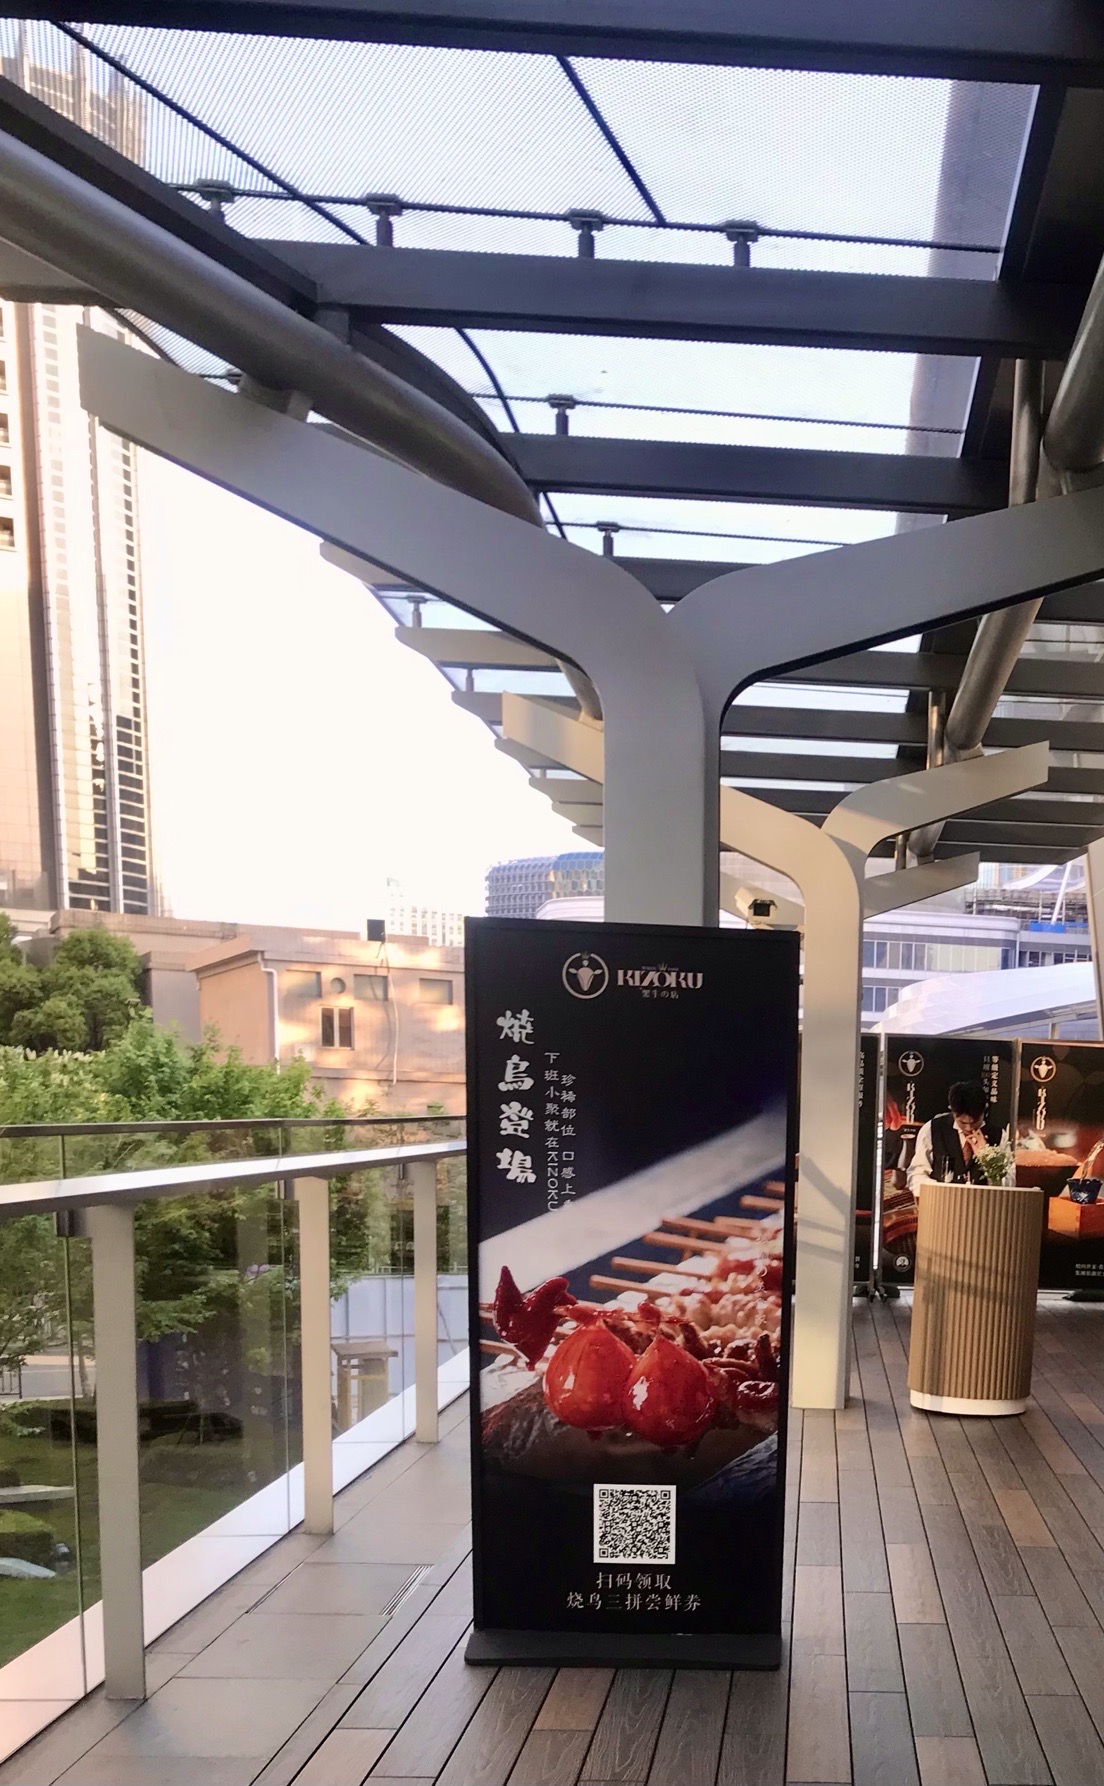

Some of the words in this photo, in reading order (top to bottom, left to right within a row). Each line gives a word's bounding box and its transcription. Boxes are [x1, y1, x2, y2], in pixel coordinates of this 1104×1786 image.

[617, 969, 704, 989] KIZOKU
[596, 1572, 672, 1590] 扫码领取
[566, 1591, 701, 1612] 烧鸟三拼尝鲜券
